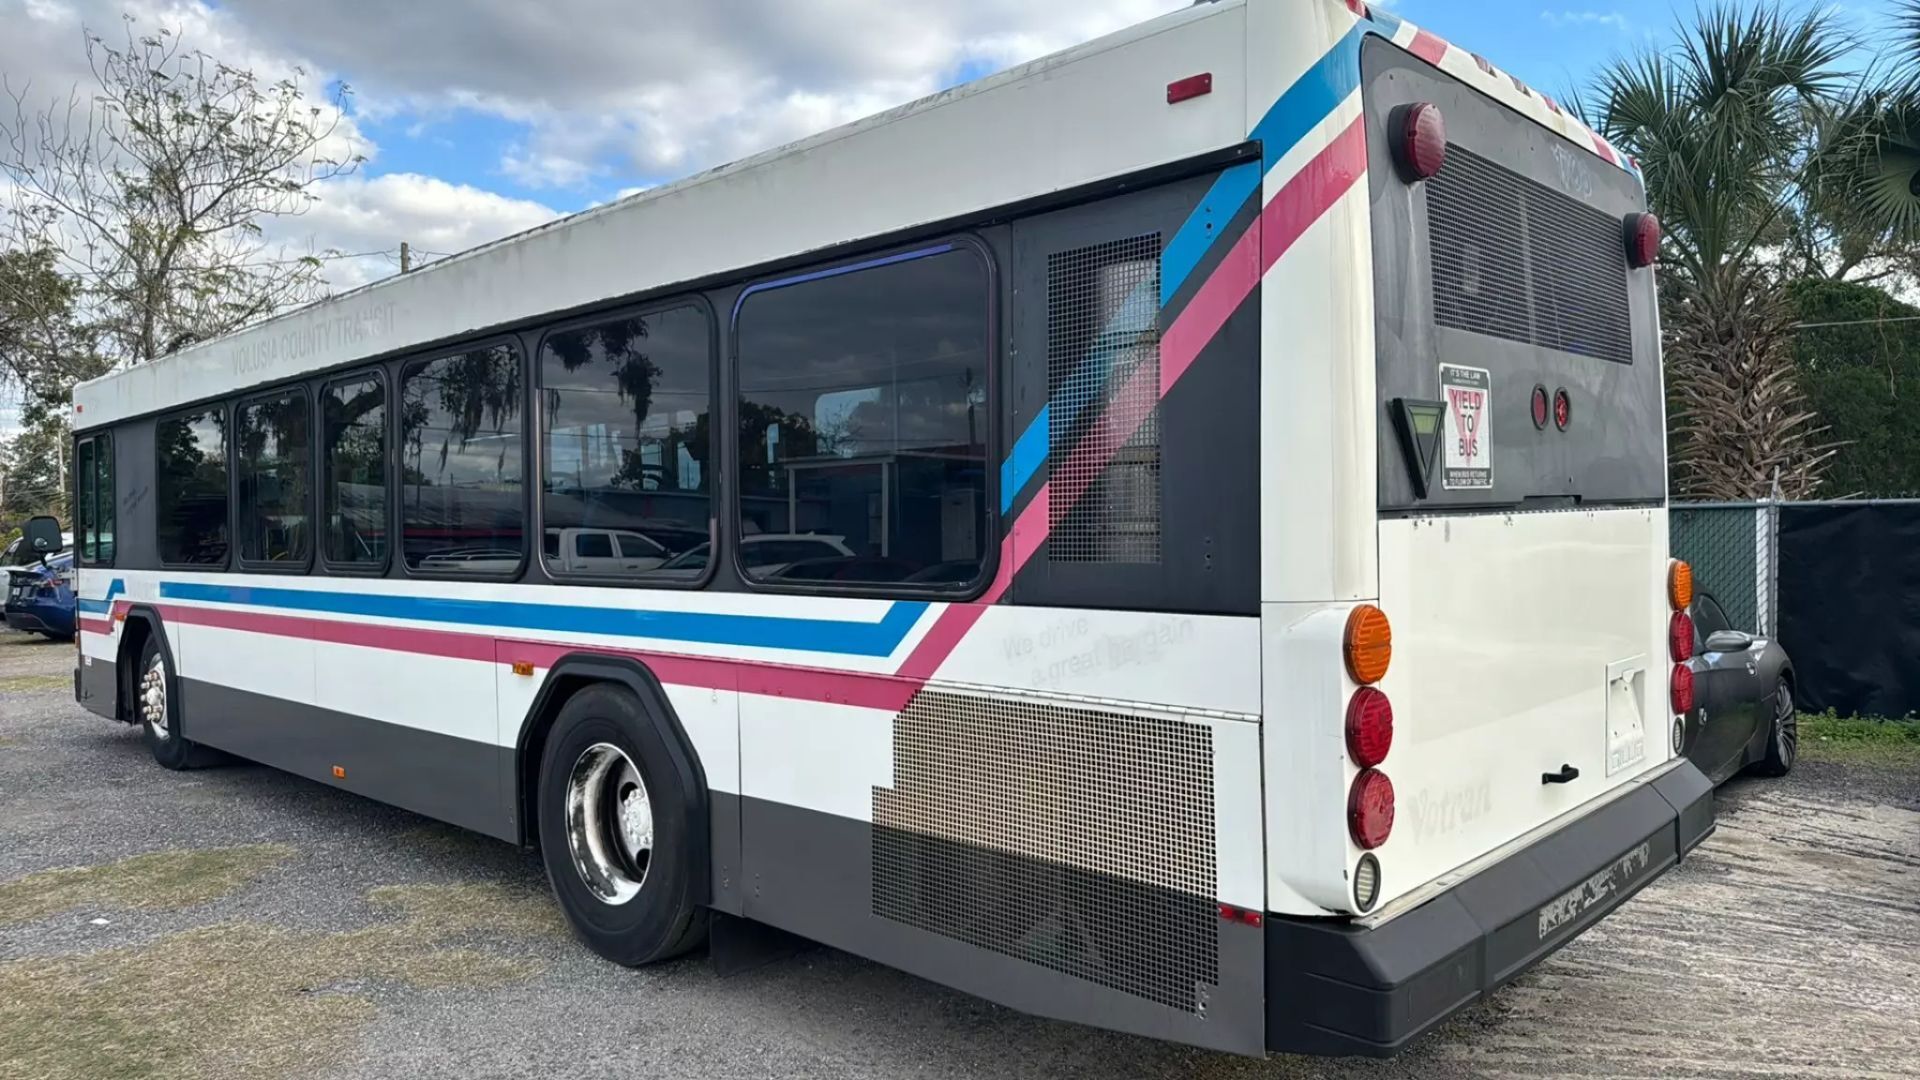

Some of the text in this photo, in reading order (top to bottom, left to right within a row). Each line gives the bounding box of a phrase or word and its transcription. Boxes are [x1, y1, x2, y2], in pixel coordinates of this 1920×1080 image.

[281, 319, 332, 362] COUNTY
[1451, 388, 1481, 411] YIELD
[1461, 414, 1474, 433] TO
[1459, 438, 1478, 457] BUS
[1002, 616, 1089, 663] We drive
[1048, 643, 1103, 686] great
